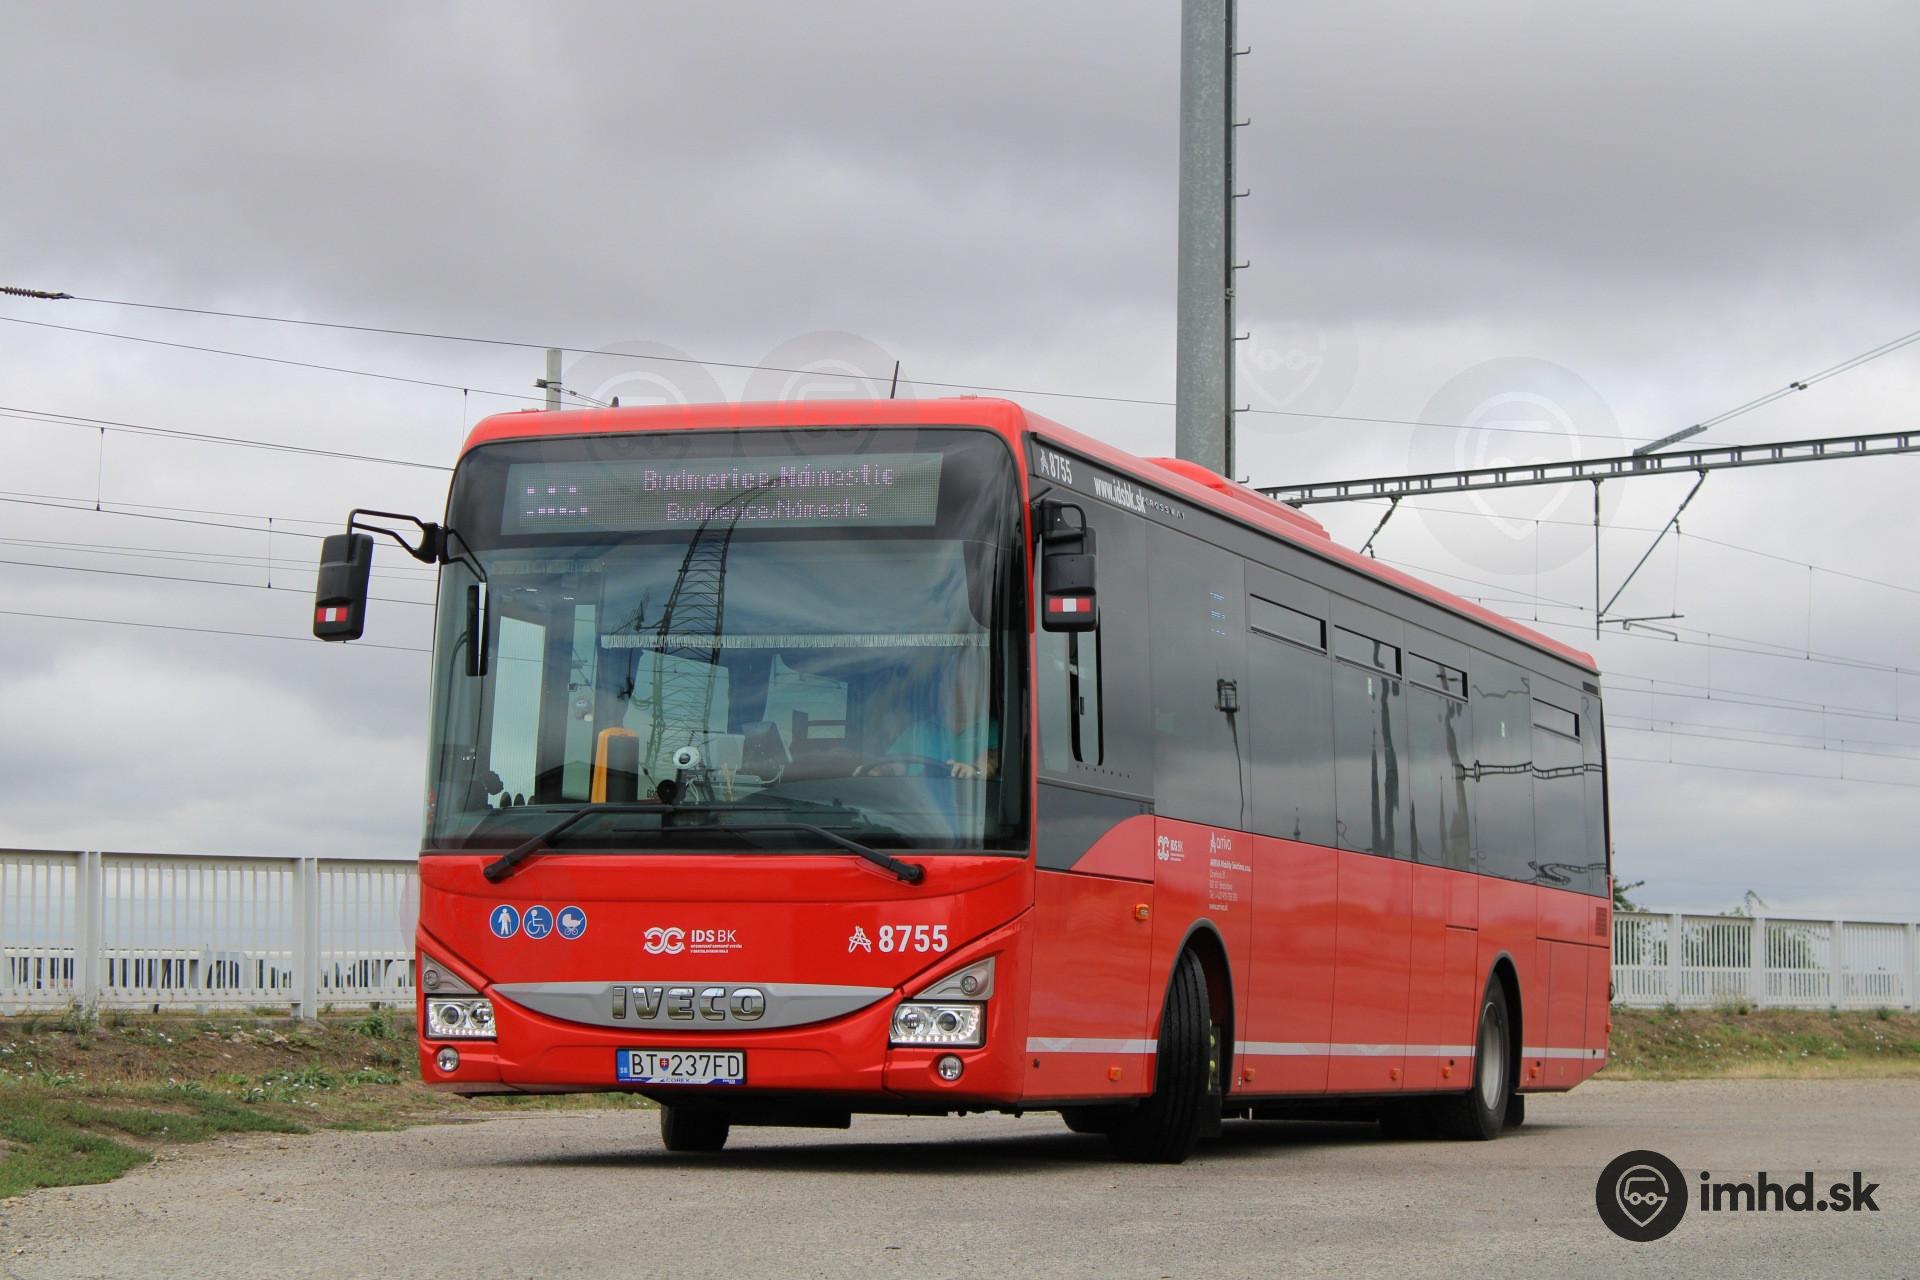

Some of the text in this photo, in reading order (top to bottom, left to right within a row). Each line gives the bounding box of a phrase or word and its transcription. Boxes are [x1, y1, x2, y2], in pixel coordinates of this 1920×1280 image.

[1049, 453, 1073, 485] 8755
[1093, 476, 1146, 513] www.idsbk.sk
[691, 929, 737, 943] IDS BK
[878, 924, 949, 953] 8755
[610, 986, 766, 1021] IVECO
[671, 1054, 740, 1077] 237FD
